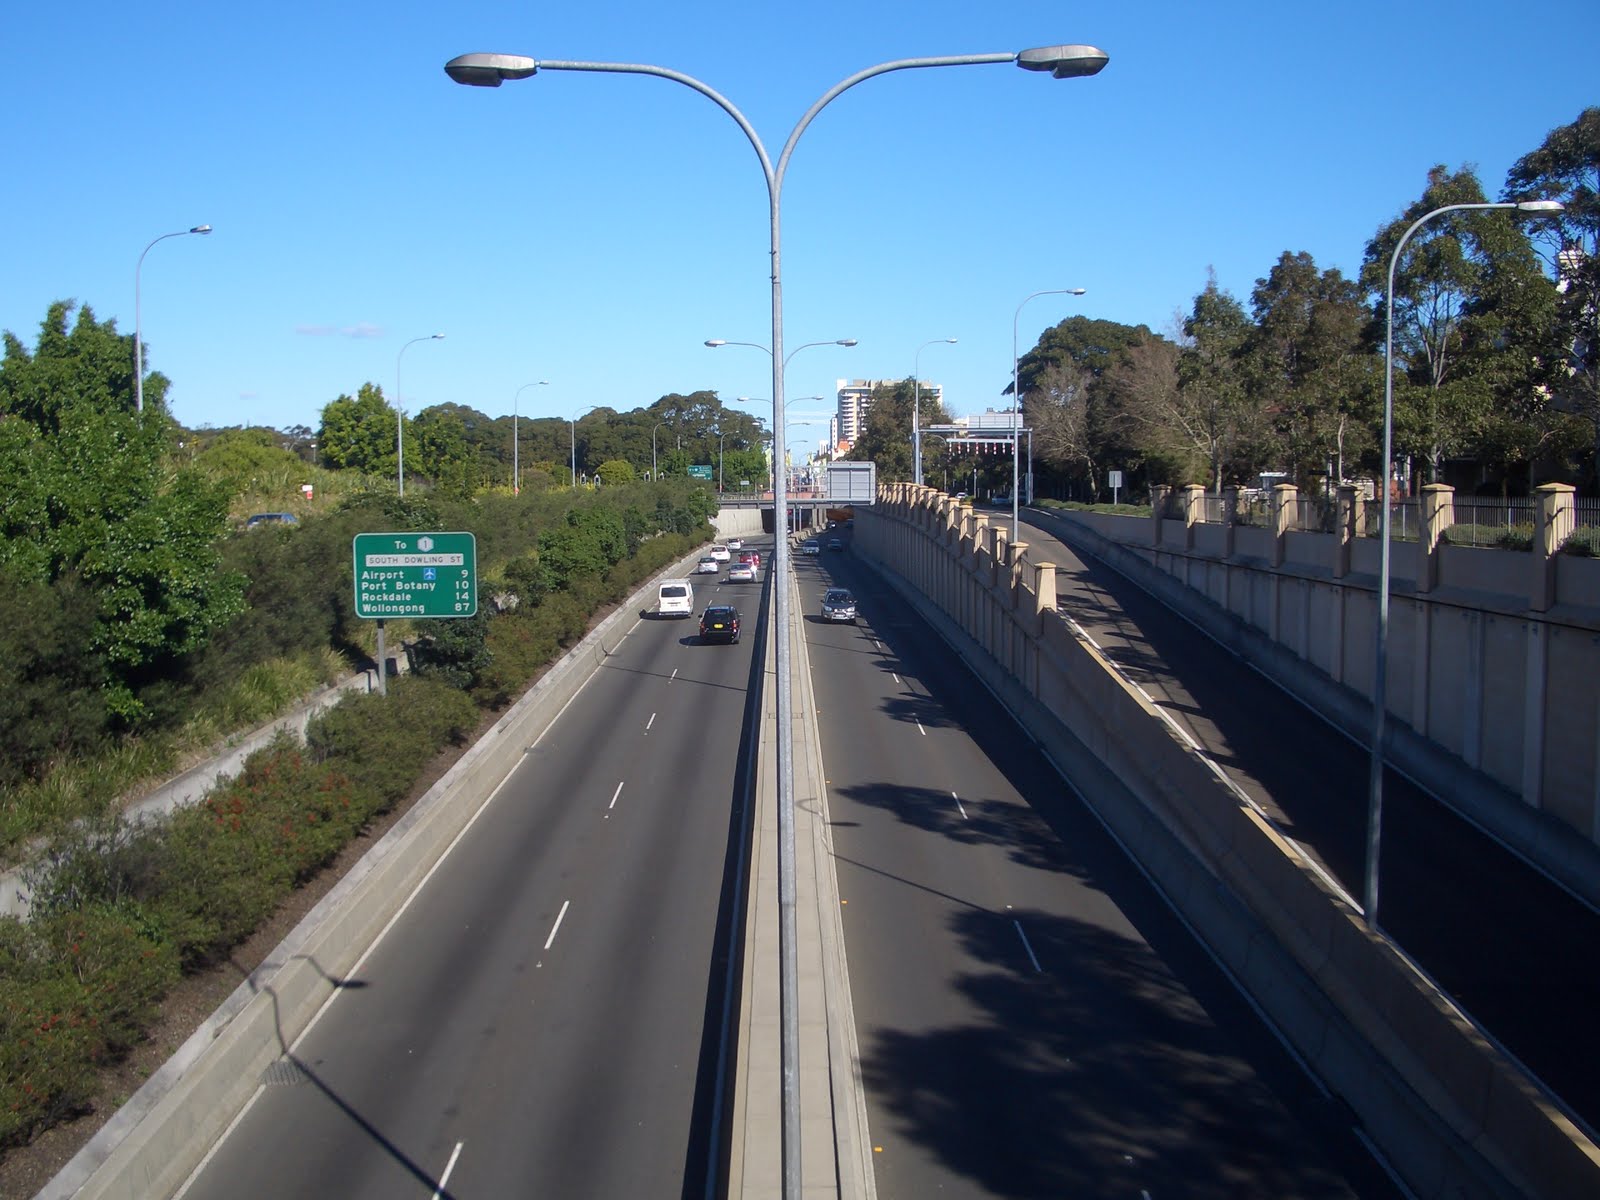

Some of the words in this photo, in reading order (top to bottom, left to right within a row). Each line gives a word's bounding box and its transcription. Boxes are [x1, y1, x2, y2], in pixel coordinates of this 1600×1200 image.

[394, 540, 407, 549] To
[361, 571, 404, 580] Airport
[461, 569, 468, 578] 9
[361, 582, 387, 590] Port
[395, 581, 436, 591] Botany
[455, 581, 469, 589] 10
[361, 593, 412, 601] Rockdale
[455, 592, 469, 600] 14
[362, 604, 425, 614] Wollongong
[454, 603, 470, 611] 87
